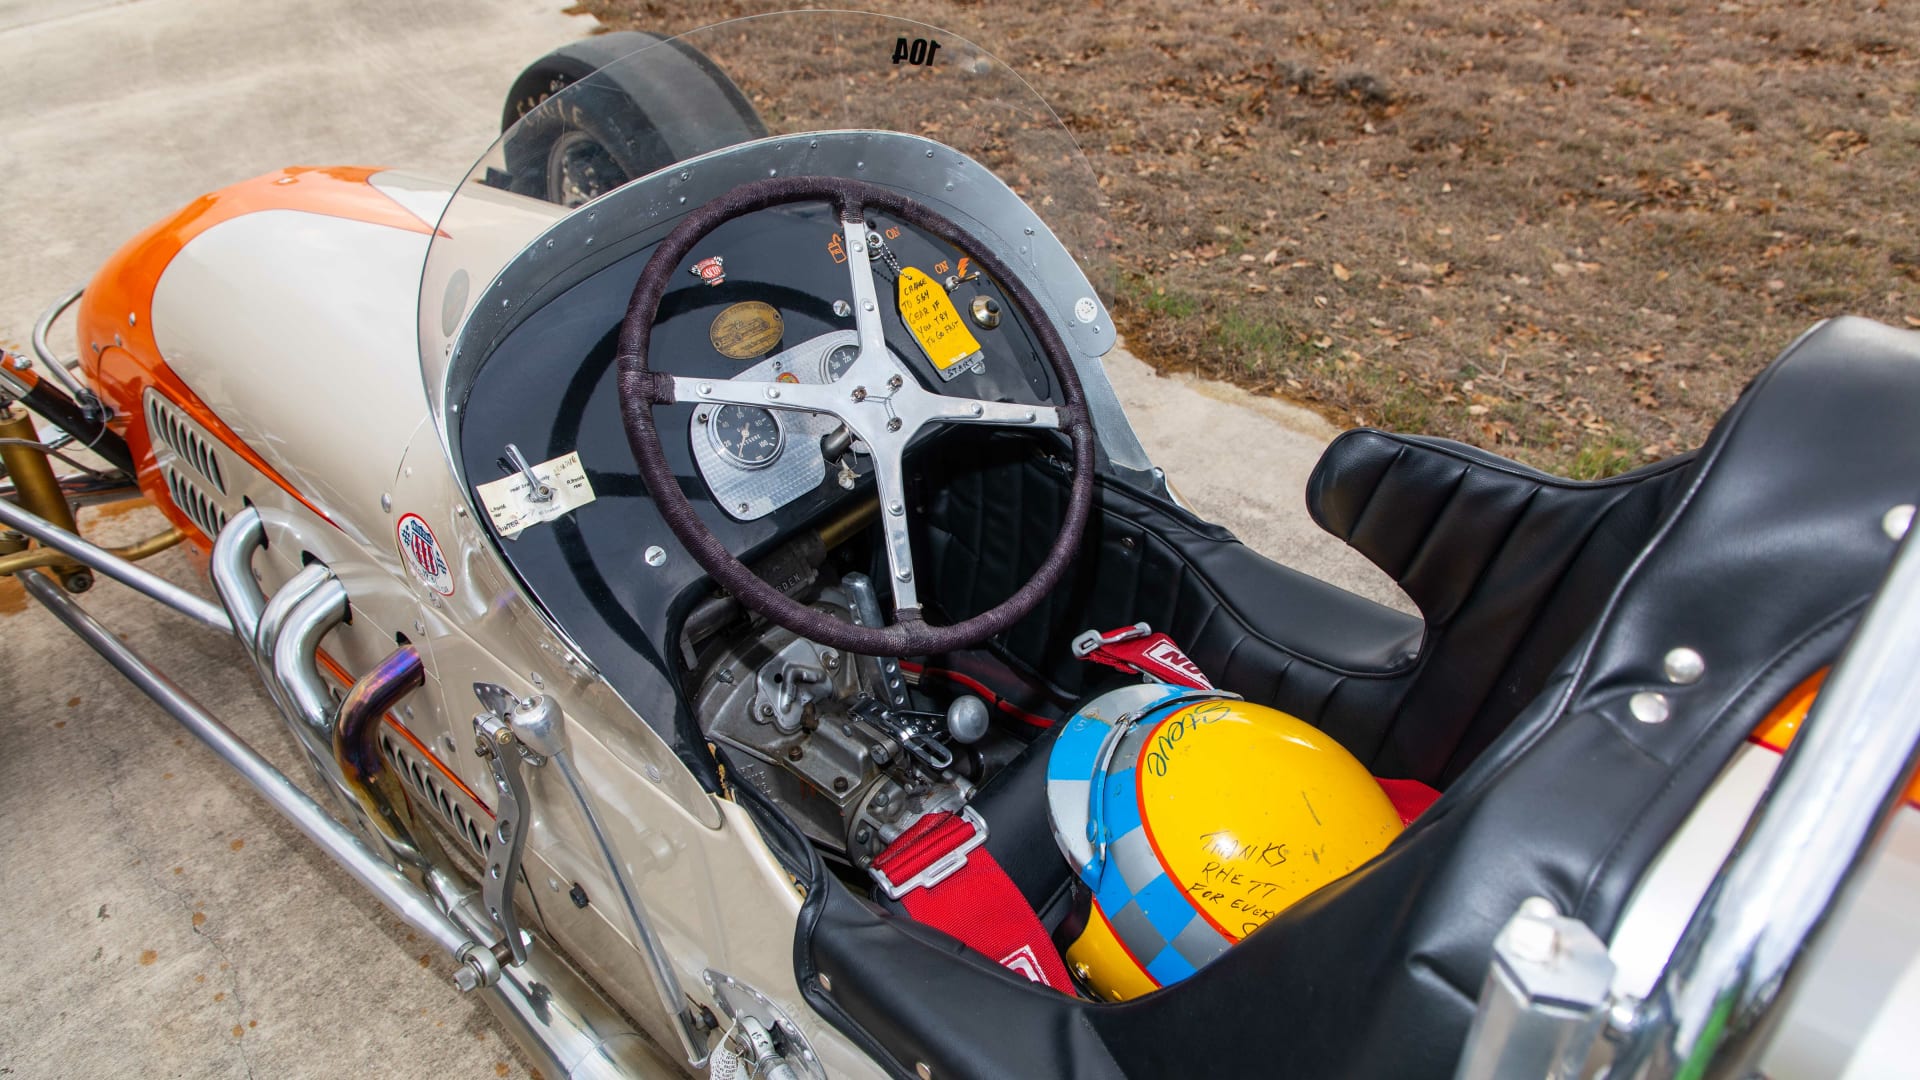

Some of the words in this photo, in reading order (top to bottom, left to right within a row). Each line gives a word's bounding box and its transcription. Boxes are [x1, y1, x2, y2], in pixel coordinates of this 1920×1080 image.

[885, 227, 901, 240] ON
[934, 260, 949, 274] ON
[901, 301, 912, 312] TO
[909, 307, 929, 324] GEAR
[932, 300, 941, 311] IF
[934, 311, 949, 324] TRY
[947, 358, 974, 378] START
[1202, 862, 1286, 898] RHETT
[1186, 882, 1225, 904] FOR
